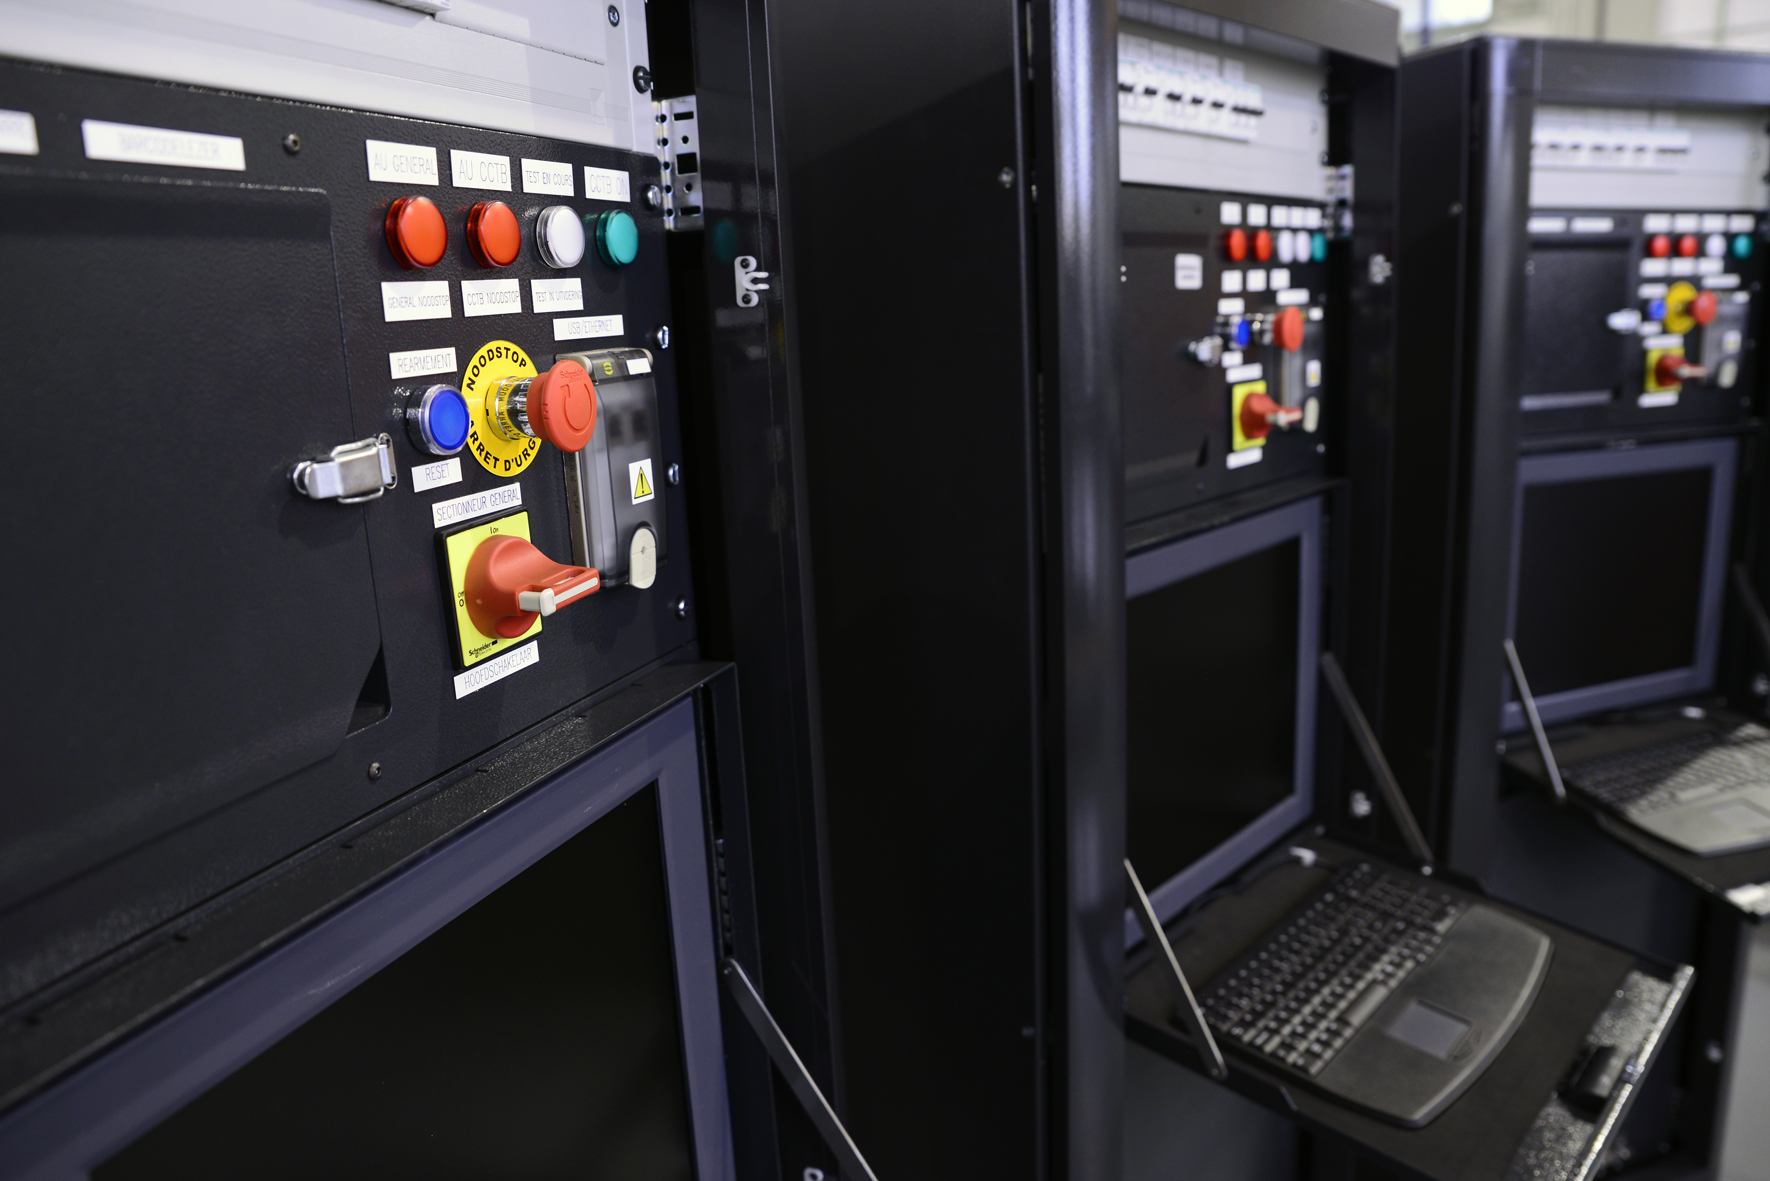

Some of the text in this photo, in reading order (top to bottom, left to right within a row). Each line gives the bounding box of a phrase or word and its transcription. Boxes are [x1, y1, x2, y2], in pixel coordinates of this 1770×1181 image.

[374, 153, 437, 176] AU GENERAL
[459, 159, 508, 184] AU CCTB
[525, 170, 573, 187] TEST EN COURS
[589, 174, 629, 196] CCTB ON
[387, 294, 450, 309] GENERAL NOODSTOP
[466, 290, 520, 306] CCTB NOODSTOP
[535, 291, 547, 303] TEST
[567, 319, 613, 337] USB/ETHERNET
[397, 353, 452, 373] REARMEMENT
[466, 346, 527, 392] NOODSTOP
[424, 462, 450, 482] RESET
[436, 487, 521, 522] SECTIONNEUR GENERAL
[468, 642, 492, 657] Schneider
[463, 647, 533, 690] HOOFDSCHAKELAAR
